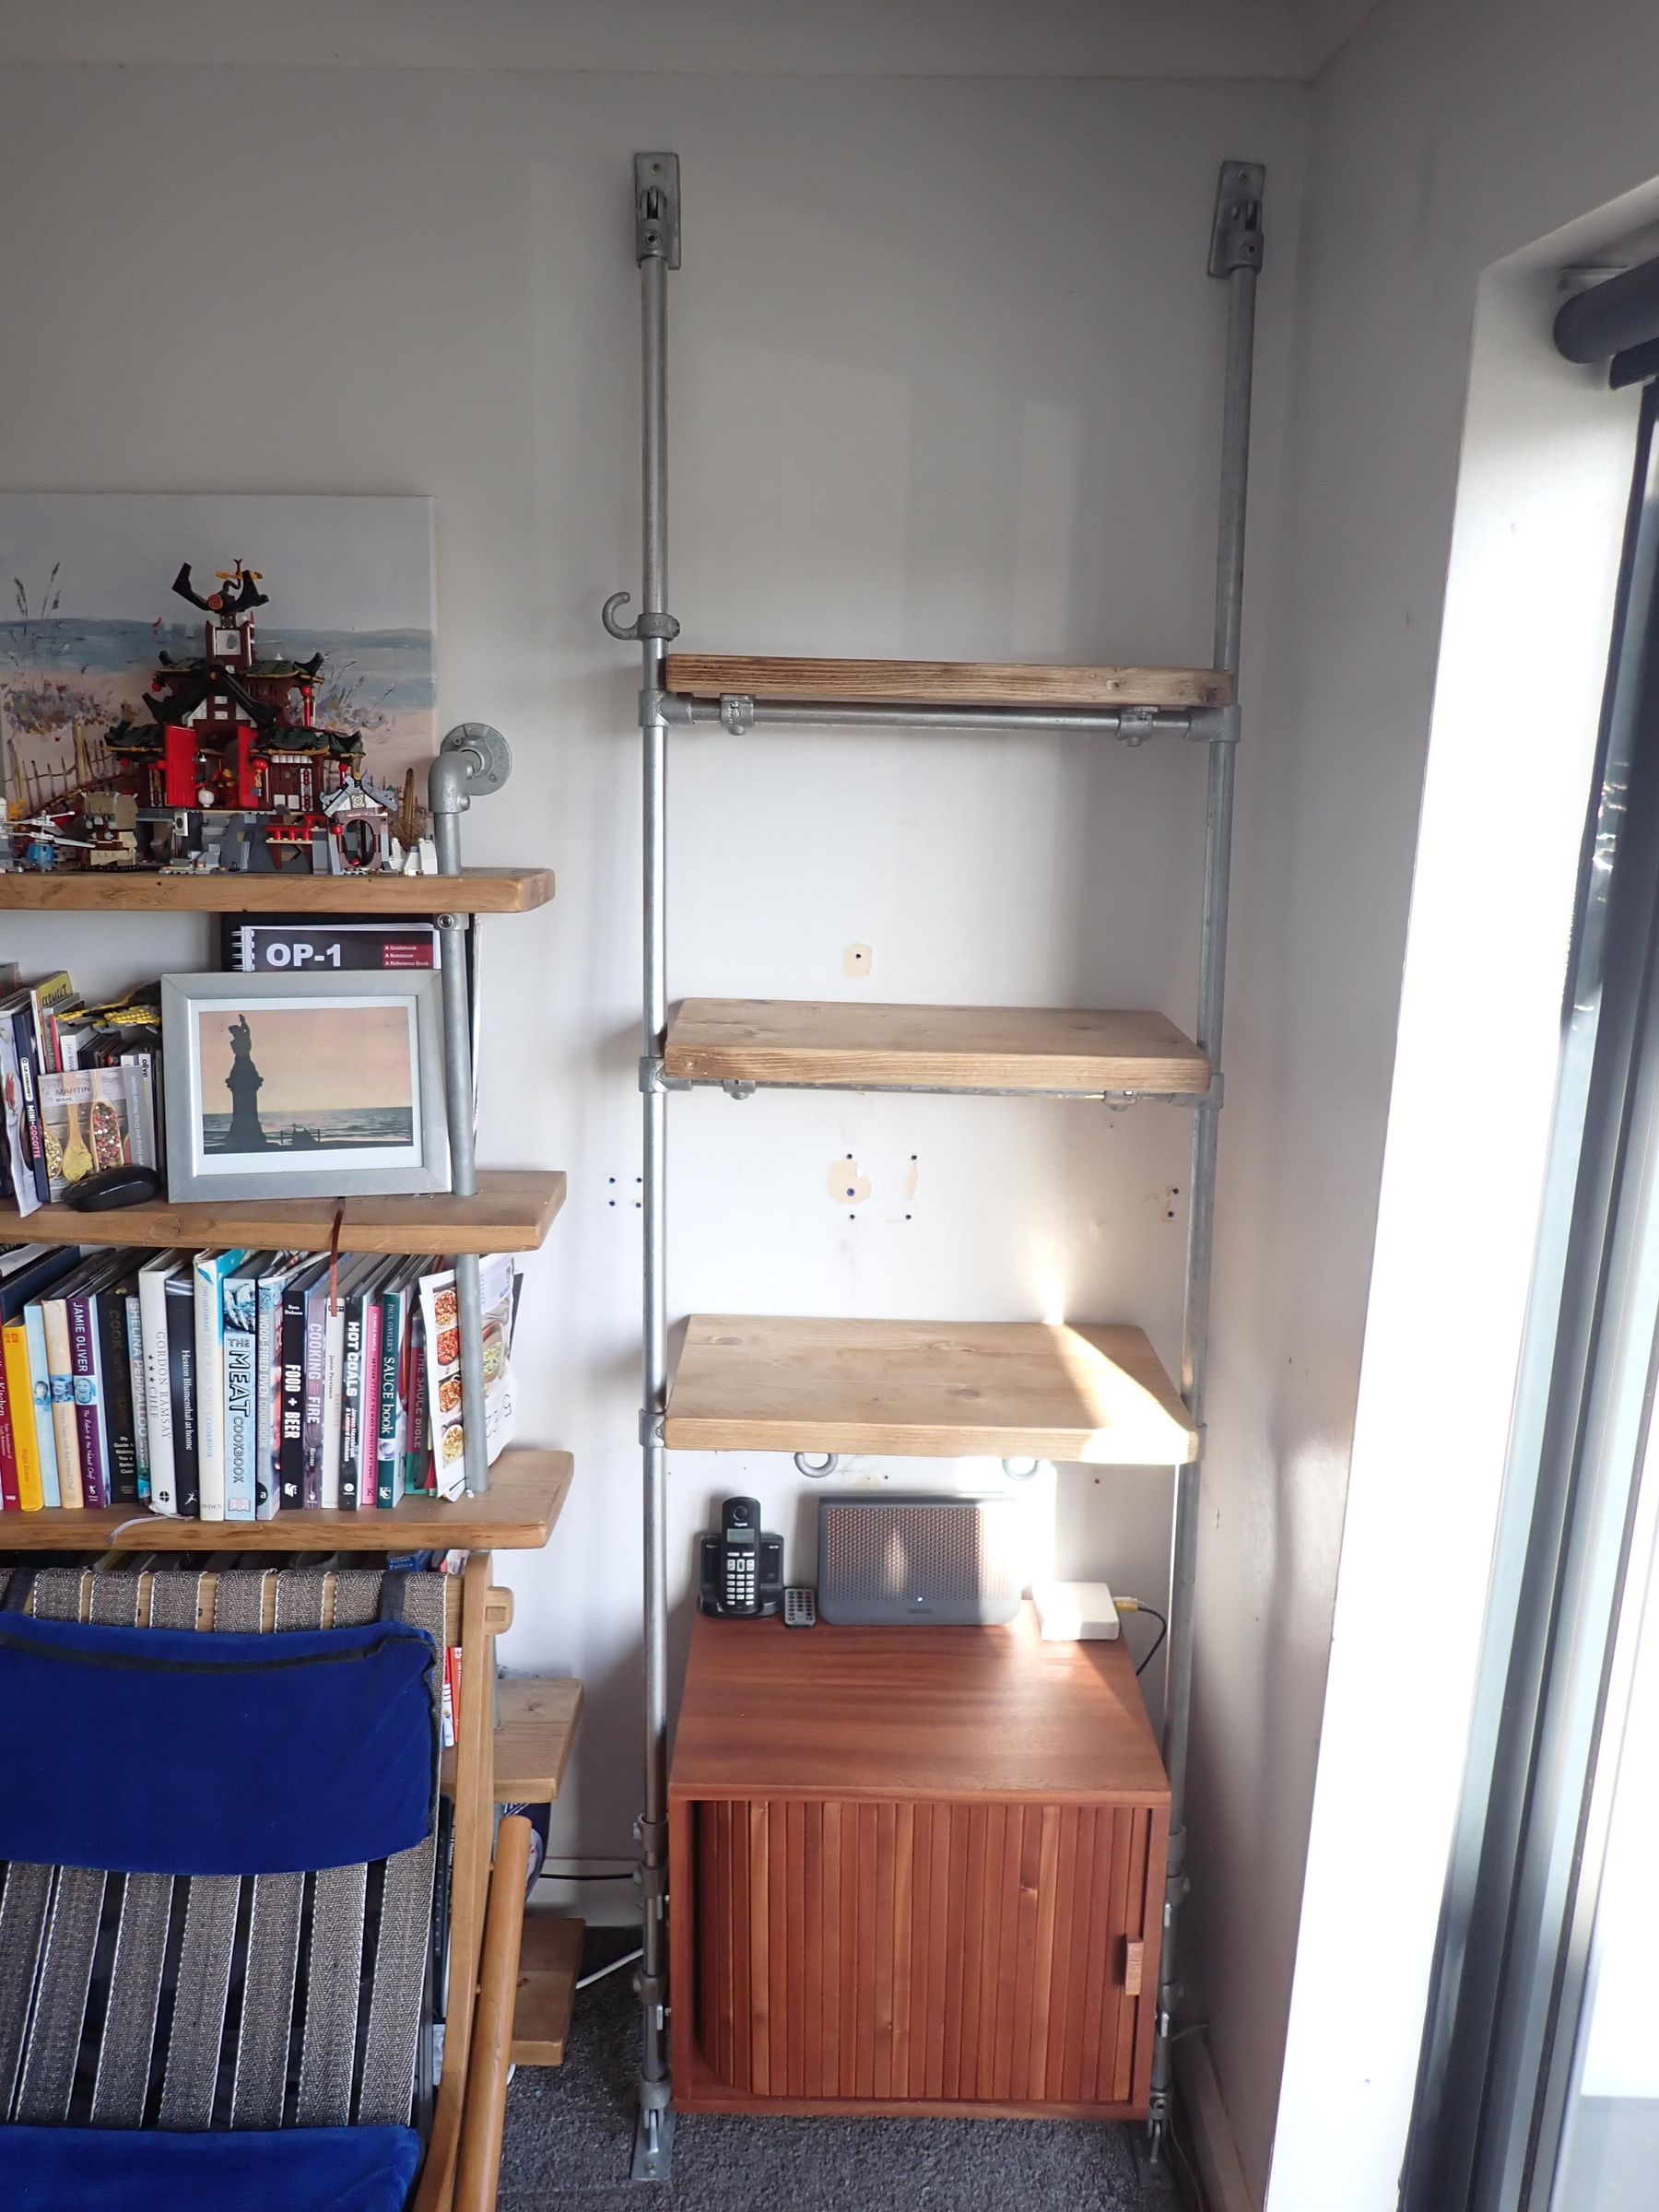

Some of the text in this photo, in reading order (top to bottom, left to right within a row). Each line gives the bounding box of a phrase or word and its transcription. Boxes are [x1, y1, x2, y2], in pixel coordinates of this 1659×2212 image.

[265, 943, 342, 968] OP-1
[55, 1087, 90, 1095] MARTIN
[27, 1104, 41, 1159] MINI-COCOTTE
[73, 1301, 88, 1372] JAMIE OLIVER
[387, 1302, 395, 1321] PAUL
[129, 1302, 148, 1437] SHELINA PERMALLOO
[227, 1337, 251, 1348] THE
[258, 1314, 270, 1373] WOOD-FIRED
[308, 1323, 323, 1380] COOKING
[346, 1321, 359, 1396] HOT COALS
[148, 1385, 158, 1419] CHEF
[155, 1331, 171, 1440] GORDON RAMSAY
[182, 1349, 194, 1451] Heston Blumenthal at home
[228, 1350, 251, 1418] MEAT
[259, 1373, 271, 1398] OVEN
[284, 1364, 301, 1439] FOOD + BEER
[307, 1396, 321, 1424] FIRE
[380, 1357, 394, 1434] SAUCE book
[413, 1352, 425, 1449] THE SAUCE BIBLE
[205, 1417, 213, 1459] COOKBOOK
[232, 1416, 245, 1484] COOKBOOK
[259, 1399, 271, 1449] COOKBOOK
